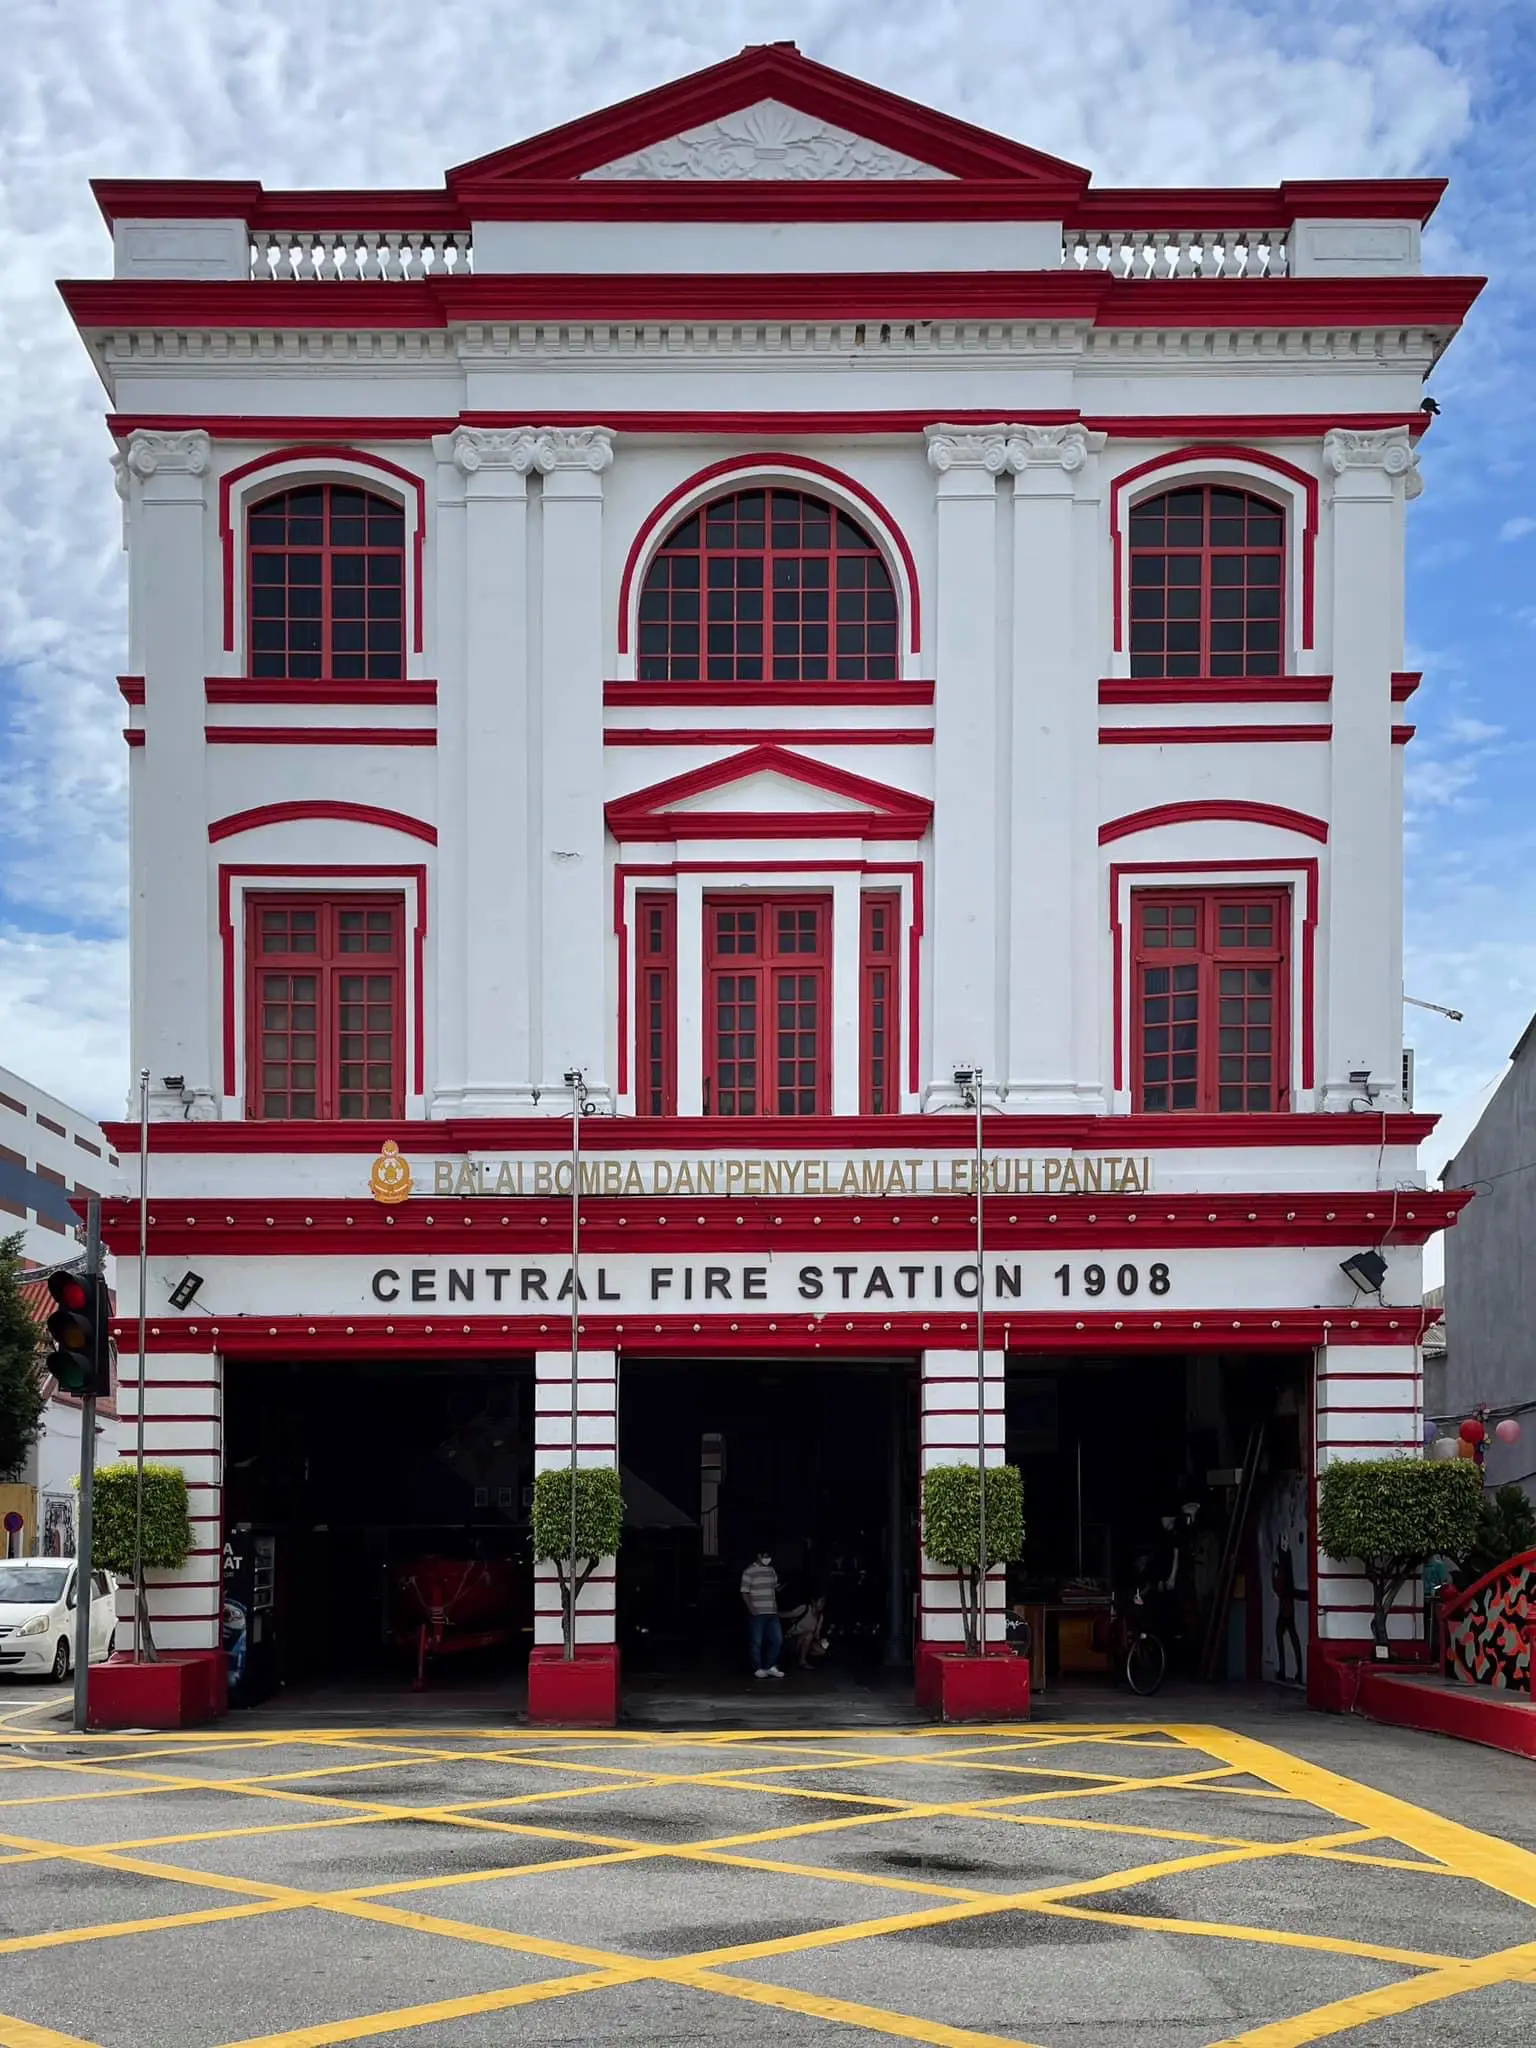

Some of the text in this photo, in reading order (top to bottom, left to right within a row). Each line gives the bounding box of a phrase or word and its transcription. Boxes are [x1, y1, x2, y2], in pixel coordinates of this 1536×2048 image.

[434, 1156, 1149, 1195] BALAI BOMBA DAN PENYELAMAT LEBUH PANTAI
[371, 1262, 1172, 1302] CENTRAL FIRE STATION 1908
